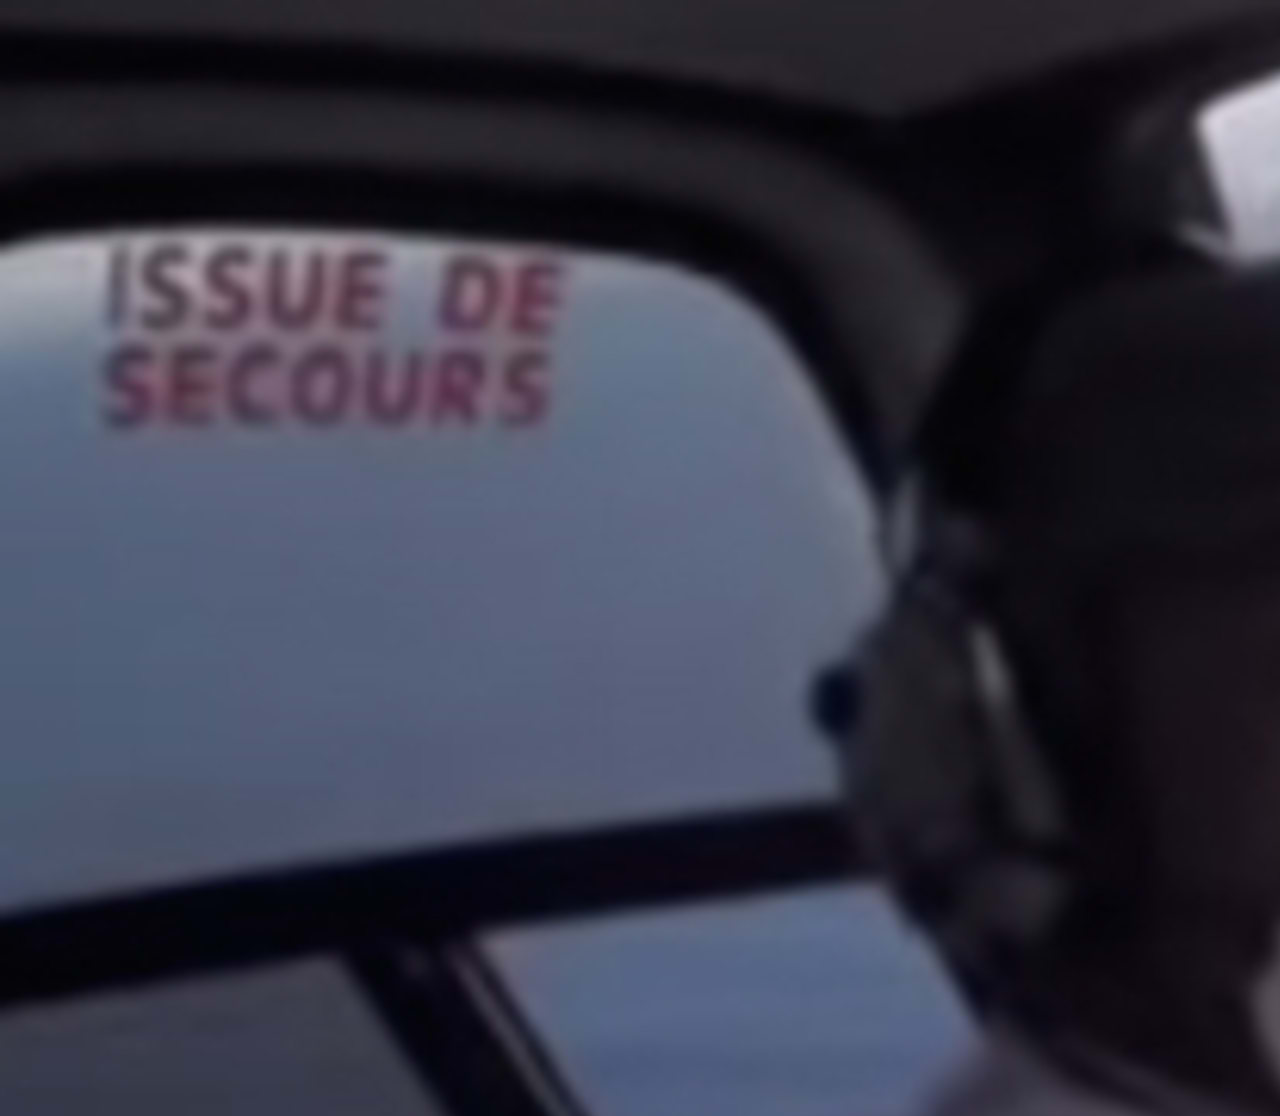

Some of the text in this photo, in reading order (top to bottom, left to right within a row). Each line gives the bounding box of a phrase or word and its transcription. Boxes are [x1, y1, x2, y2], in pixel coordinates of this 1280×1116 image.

[106, 242, 566, 337] ISSUE DE
[101, 341, 552, 430] SECOURS
